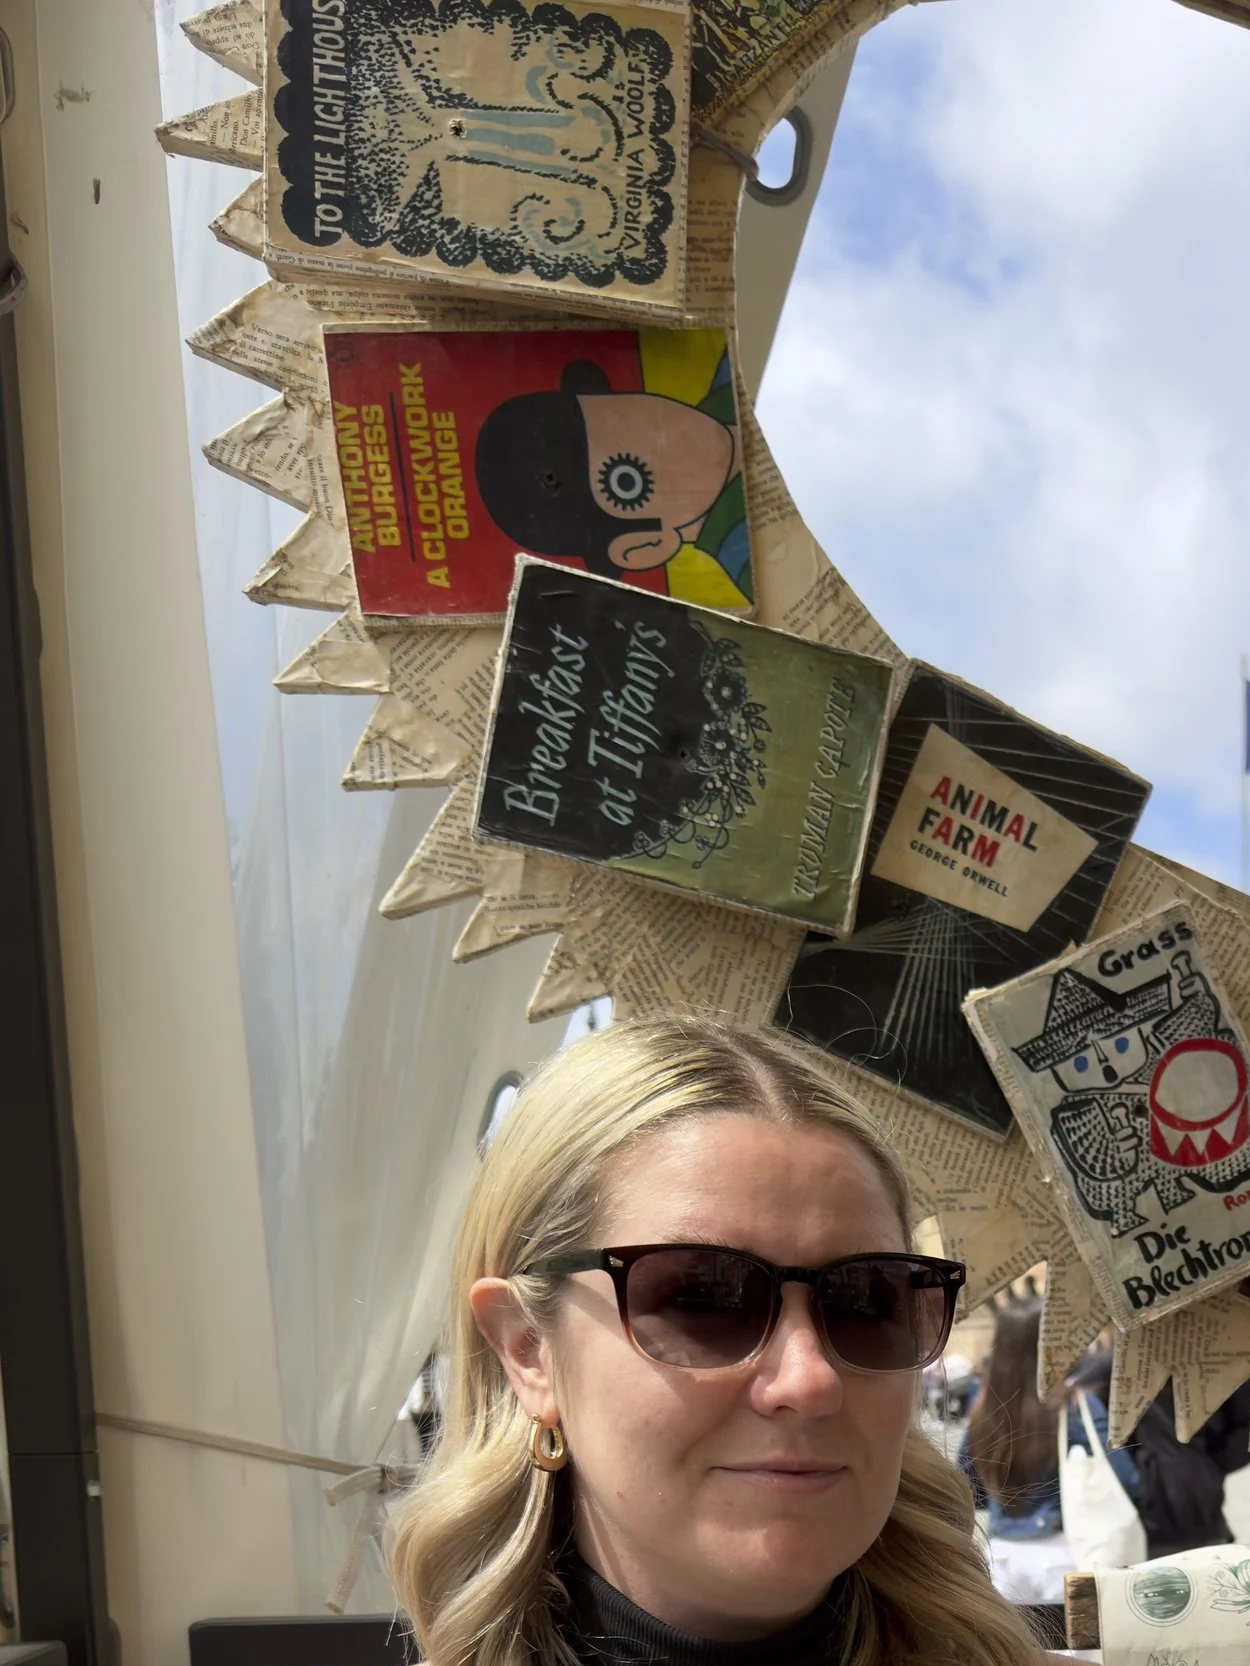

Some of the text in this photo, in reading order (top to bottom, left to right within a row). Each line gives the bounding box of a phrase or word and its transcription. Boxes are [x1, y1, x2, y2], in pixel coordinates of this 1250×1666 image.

[239, 128, 250, 146] Don
[314, 151, 347, 199] THE
[622, 58, 646, 252] VIRGINIA WOOLF
[314, 203, 344, 238] TO
[332, 400, 376, 553] ANTHONY
[361, 404, 401, 547] BURGESS
[399, 362, 453, 589] A CLOCKWORK
[432, 411, 470, 540] ORANGE
[504, 622, 590, 828] Breakfast
[587, 618, 676, 828] at Tiffany's
[813, 676, 857, 780] CAPOTE
[917, 807, 1001, 868] FARM
[929, 775, 1039, 853] ANIMAL
[909, 839, 1009, 897] GEORGE ORWELL
[1097, 921, 1194, 978] Grass
[1133, 1221, 1191, 1265] Die
